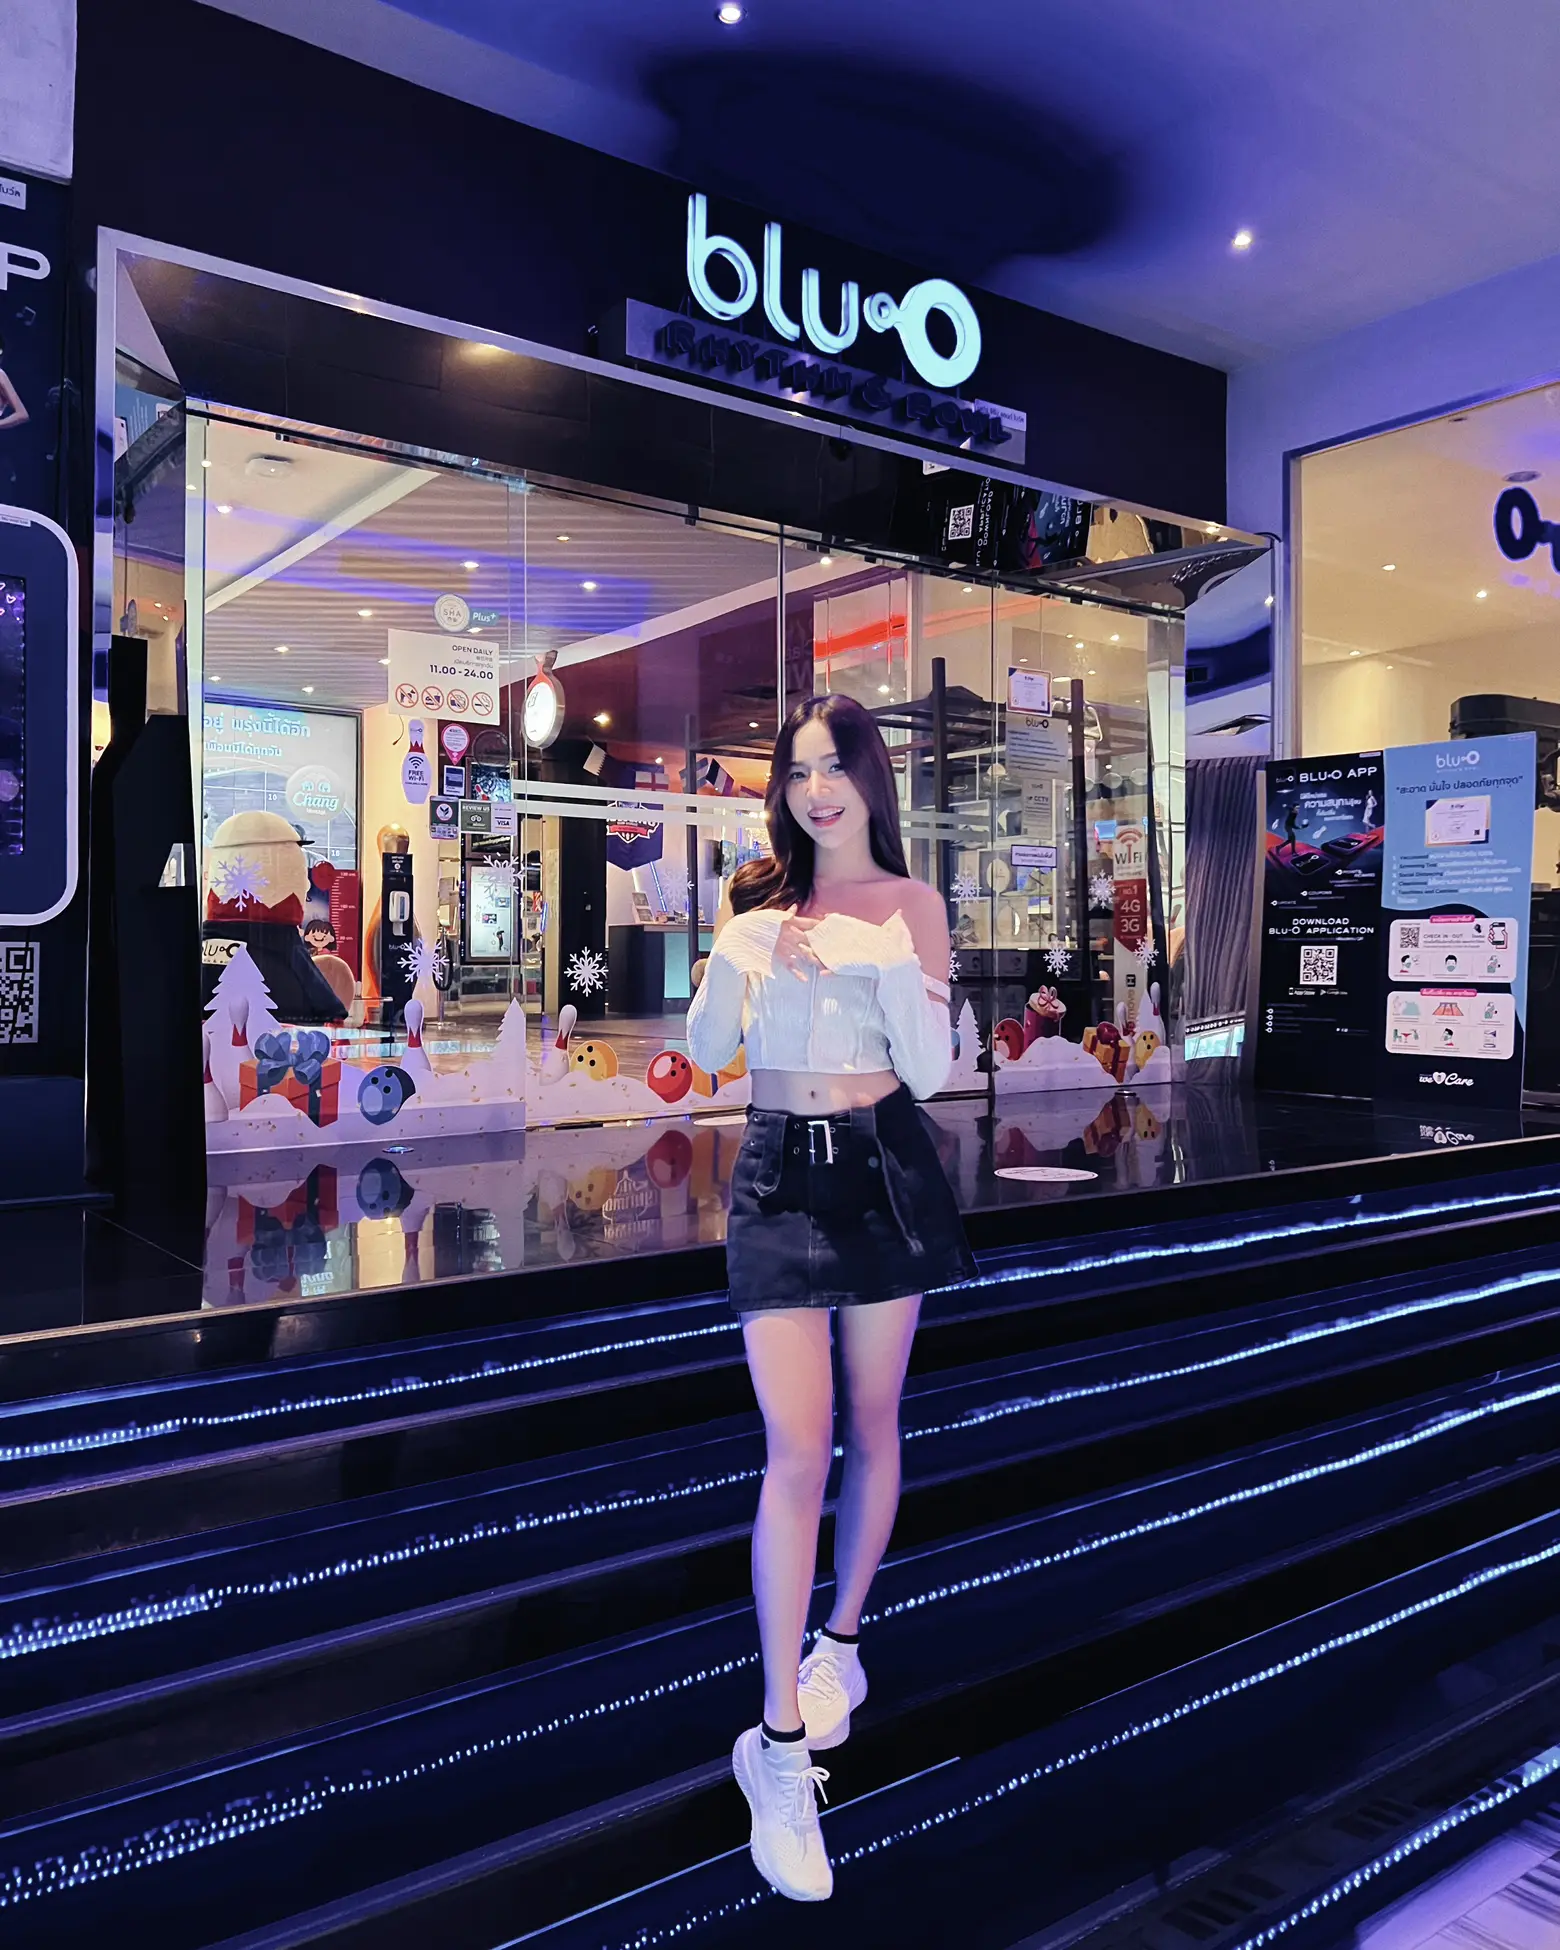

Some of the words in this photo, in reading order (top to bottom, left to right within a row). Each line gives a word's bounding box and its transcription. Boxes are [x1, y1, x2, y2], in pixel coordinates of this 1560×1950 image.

[658, 320, 852, 398] RHYTHM
[902, 391, 1012, 445] BOWL
[452, 644, 472, 653] OPEN
[473, 647, 493, 656] DAILY
[429, 664, 456, 675] 11.00
[463, 668, 494, 680] 24.00
[1346, 766, 1378, 779] APP
[292, 791, 340, 811] Chang
[1121, 899, 1141, 913] 4G
[1121, 918, 1140, 932] 3G
[1292, 917, 1350, 926] DOWNLOAD
[1306, 926, 1375, 935] APPLICATION
[1444, 1072, 1474, 1086] Care
